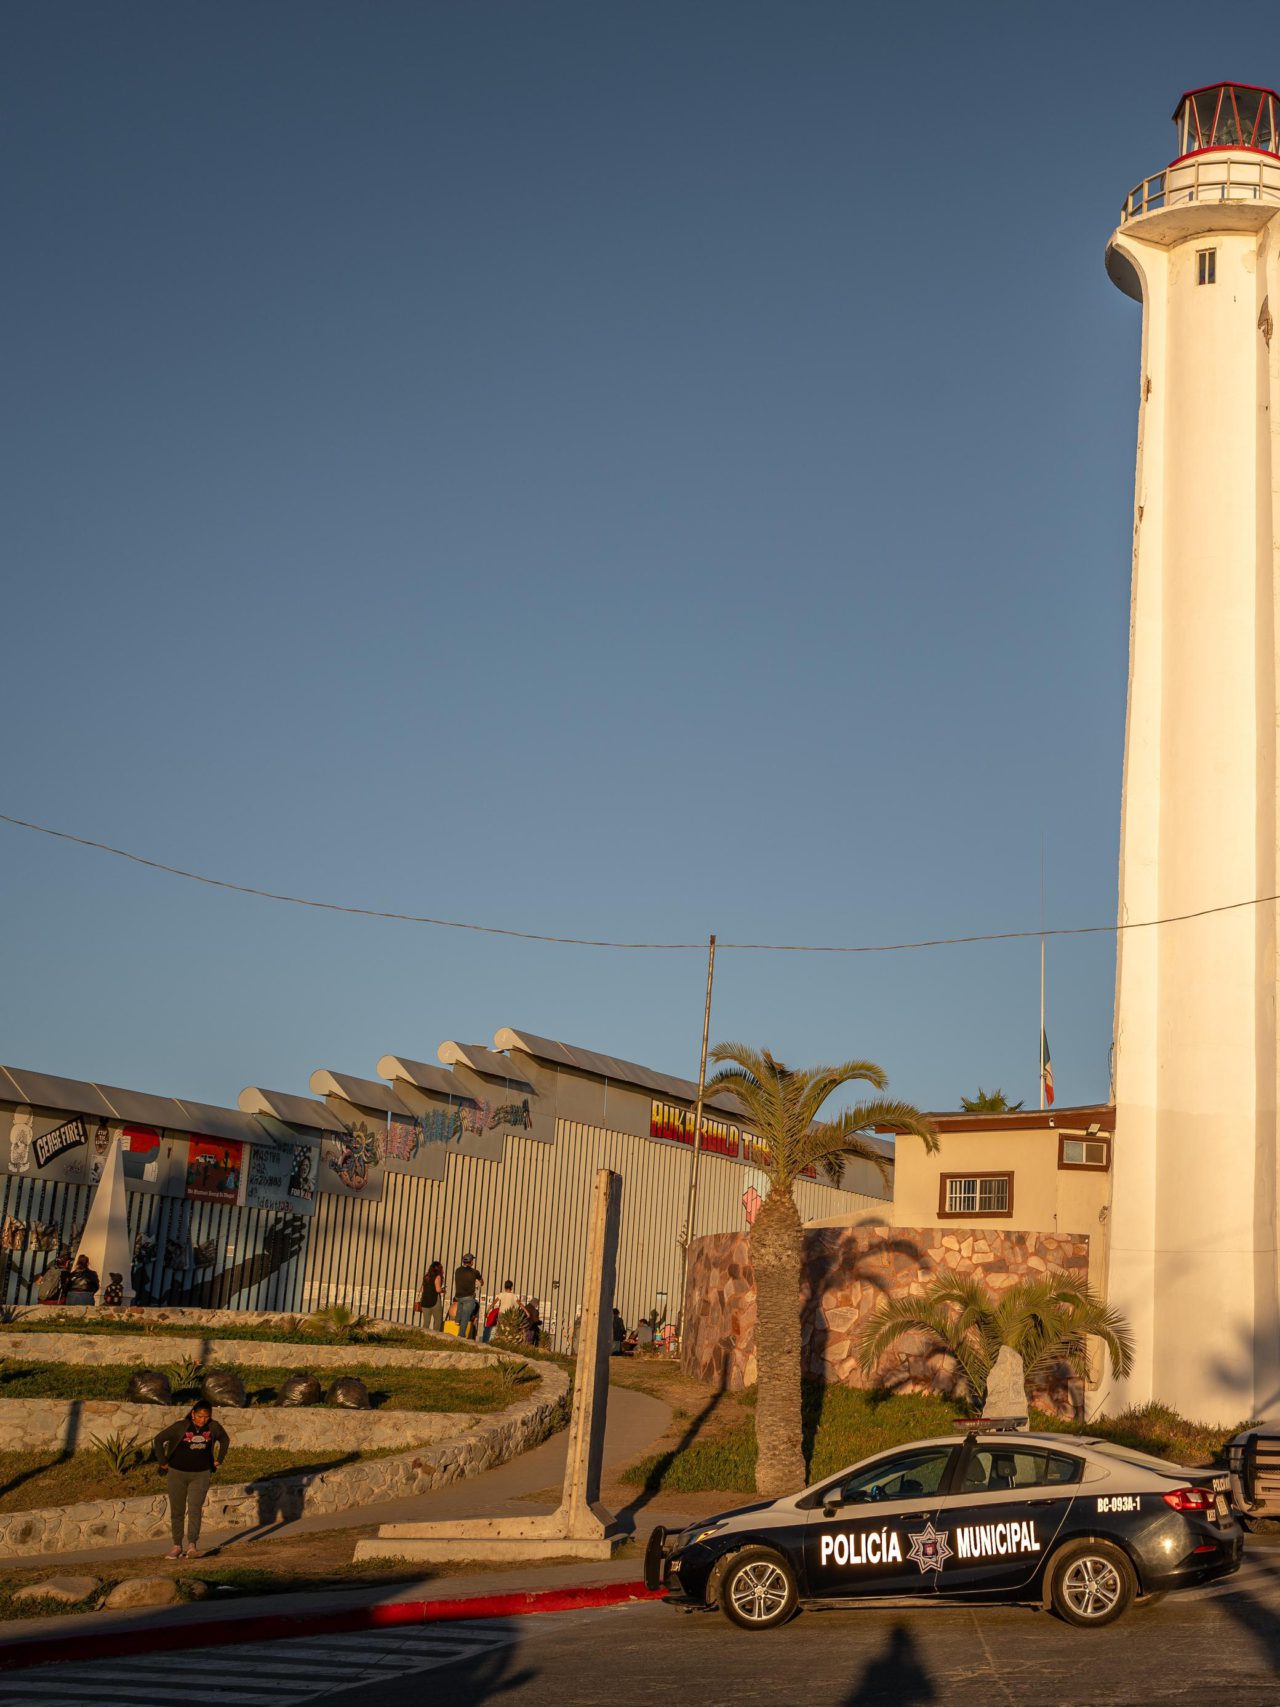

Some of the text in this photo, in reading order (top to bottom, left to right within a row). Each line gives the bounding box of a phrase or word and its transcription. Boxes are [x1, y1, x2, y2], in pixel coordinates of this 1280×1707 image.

[36, 1130, 62, 1165] CEASE
[1097, 1496, 1140, 1512] BC-093A-1
[821, 1520, 1040, 1566] POLICÍA MUNICIPAL
